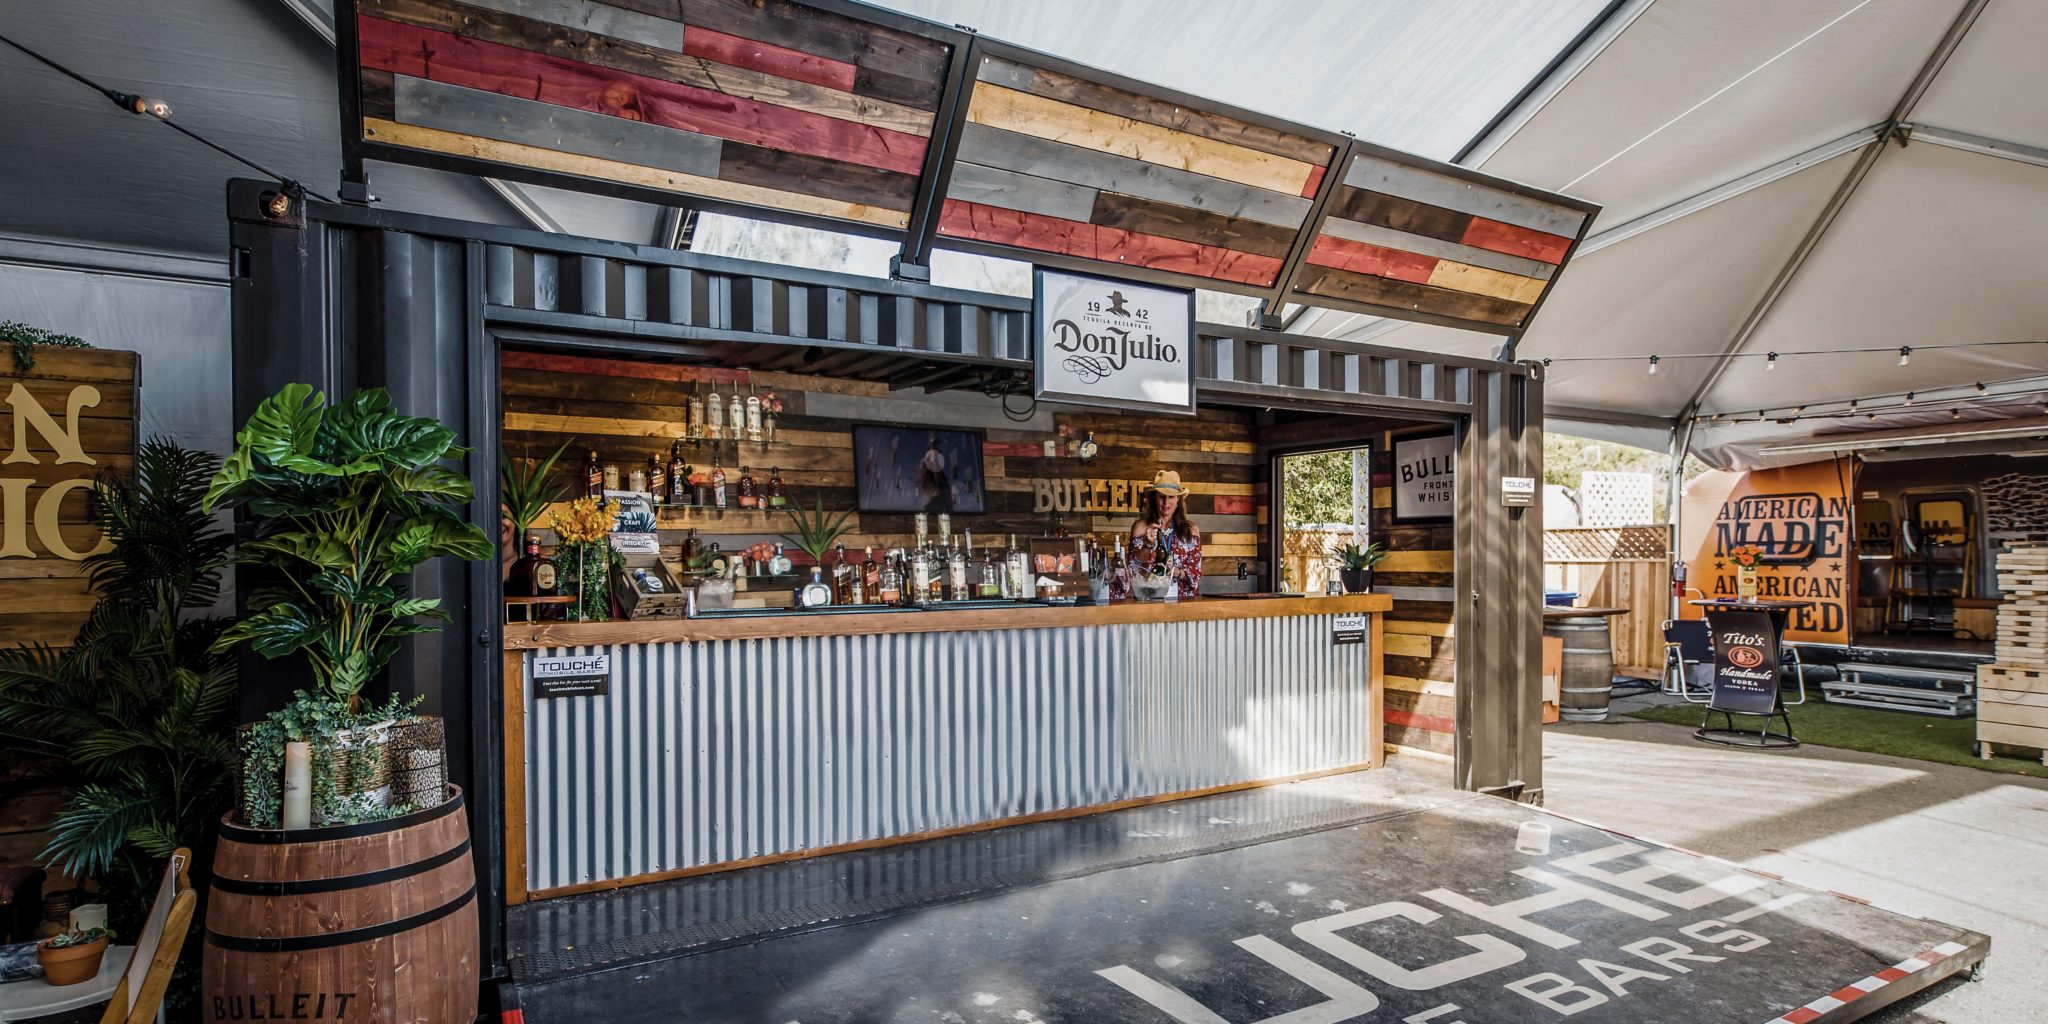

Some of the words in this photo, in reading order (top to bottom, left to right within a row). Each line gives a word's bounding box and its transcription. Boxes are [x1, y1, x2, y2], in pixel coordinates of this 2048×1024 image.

[1087, 301, 1101, 312] 19
[1135, 308, 1149, 320] 42
[1032, 477, 1152, 513] BULLEI
[1418, 491, 1454, 503] WHIS
[1716, 496, 1847, 521] AMERICAN
[1714, 520, 1845, 558] MADE
[538, 656, 604, 672] TOUCHÉ
[1720, 666, 1772, 680] Handmade
[1503, 919, 1772, 1016] BARS
[213, 993, 357, 1021] BULLEIT
